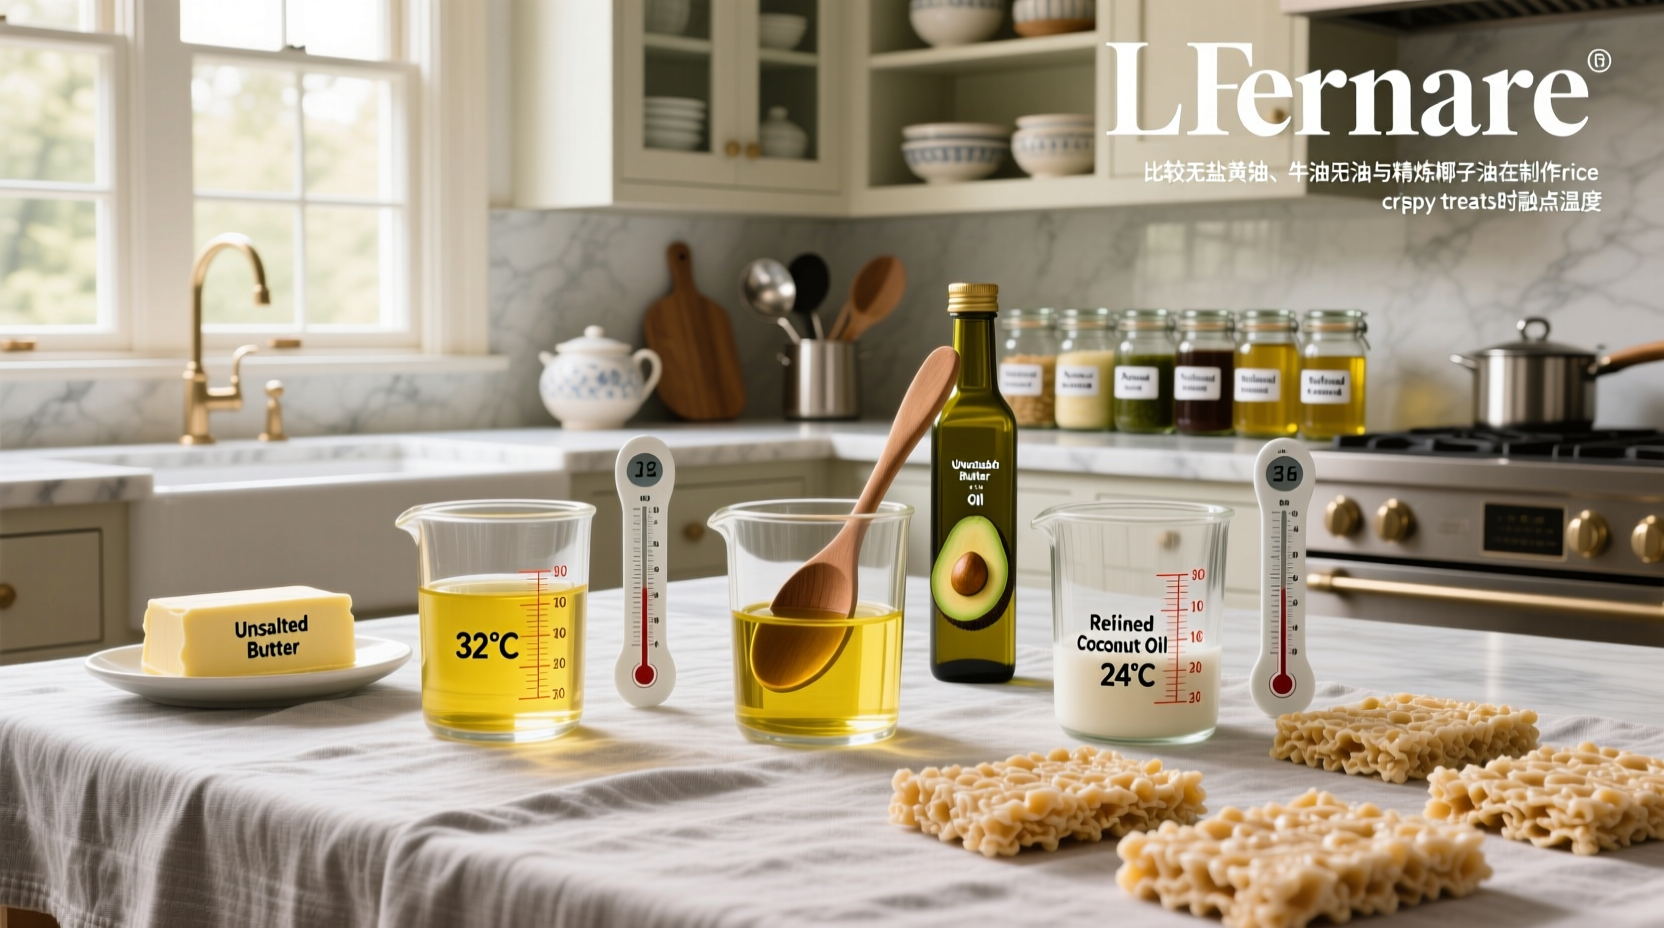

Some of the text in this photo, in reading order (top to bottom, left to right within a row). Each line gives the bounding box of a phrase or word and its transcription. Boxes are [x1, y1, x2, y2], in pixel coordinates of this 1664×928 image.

[1272, 465, 1297, 482] 36
[235, 614, 308, 638] Unsalted
[247, 640, 300, 659] Butter
[455, 631, 519, 660] 32°C
[1077, 635, 1168, 654] Coconut Oil
[1100, 662, 1156, 687] 24°C
